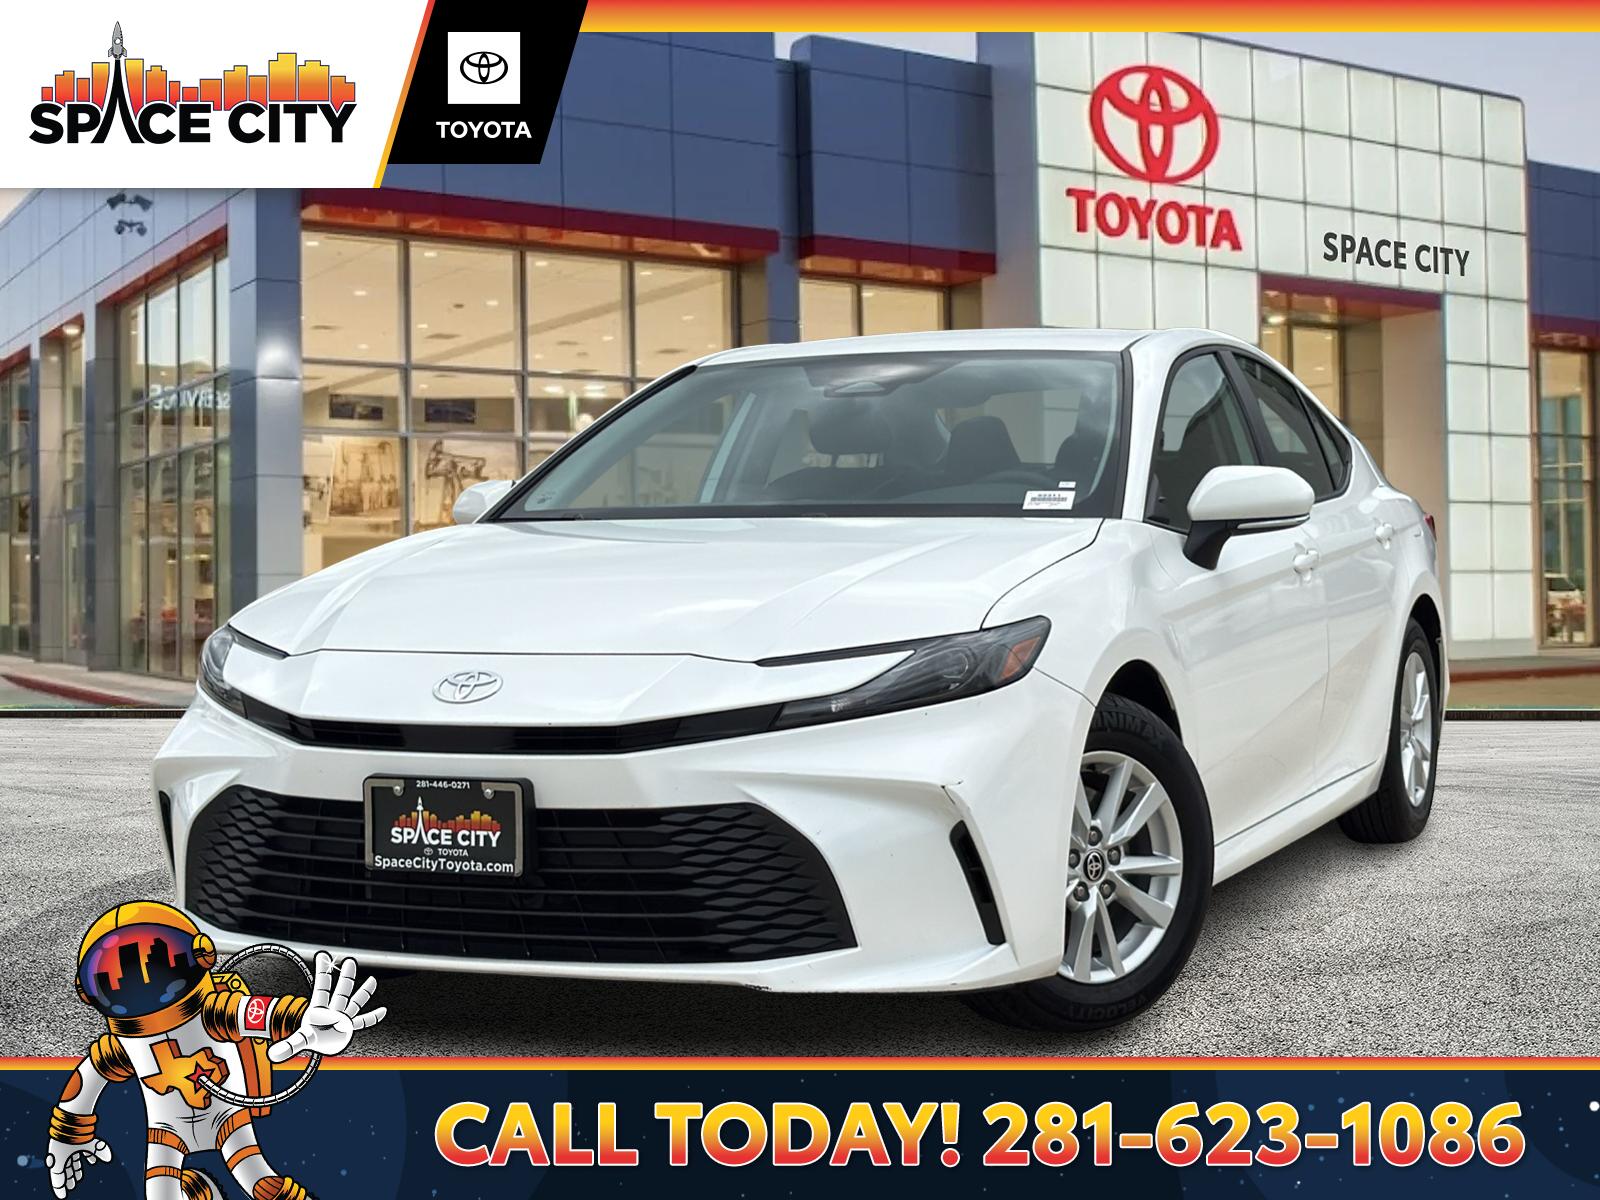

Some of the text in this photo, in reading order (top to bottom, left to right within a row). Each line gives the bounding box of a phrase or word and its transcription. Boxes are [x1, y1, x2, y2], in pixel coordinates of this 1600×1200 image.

[1066, 187, 1243, 252] TOYOTA
[1323, 231, 1471, 277] SPACE CITY
[416, 780, 470, 789] 281-446-0271
[390, 822, 502, 848] SPACE CITY
[437, 847, 469, 857] TOYOTA
[374, 855, 514, 873] SpaceCityToyota.com
